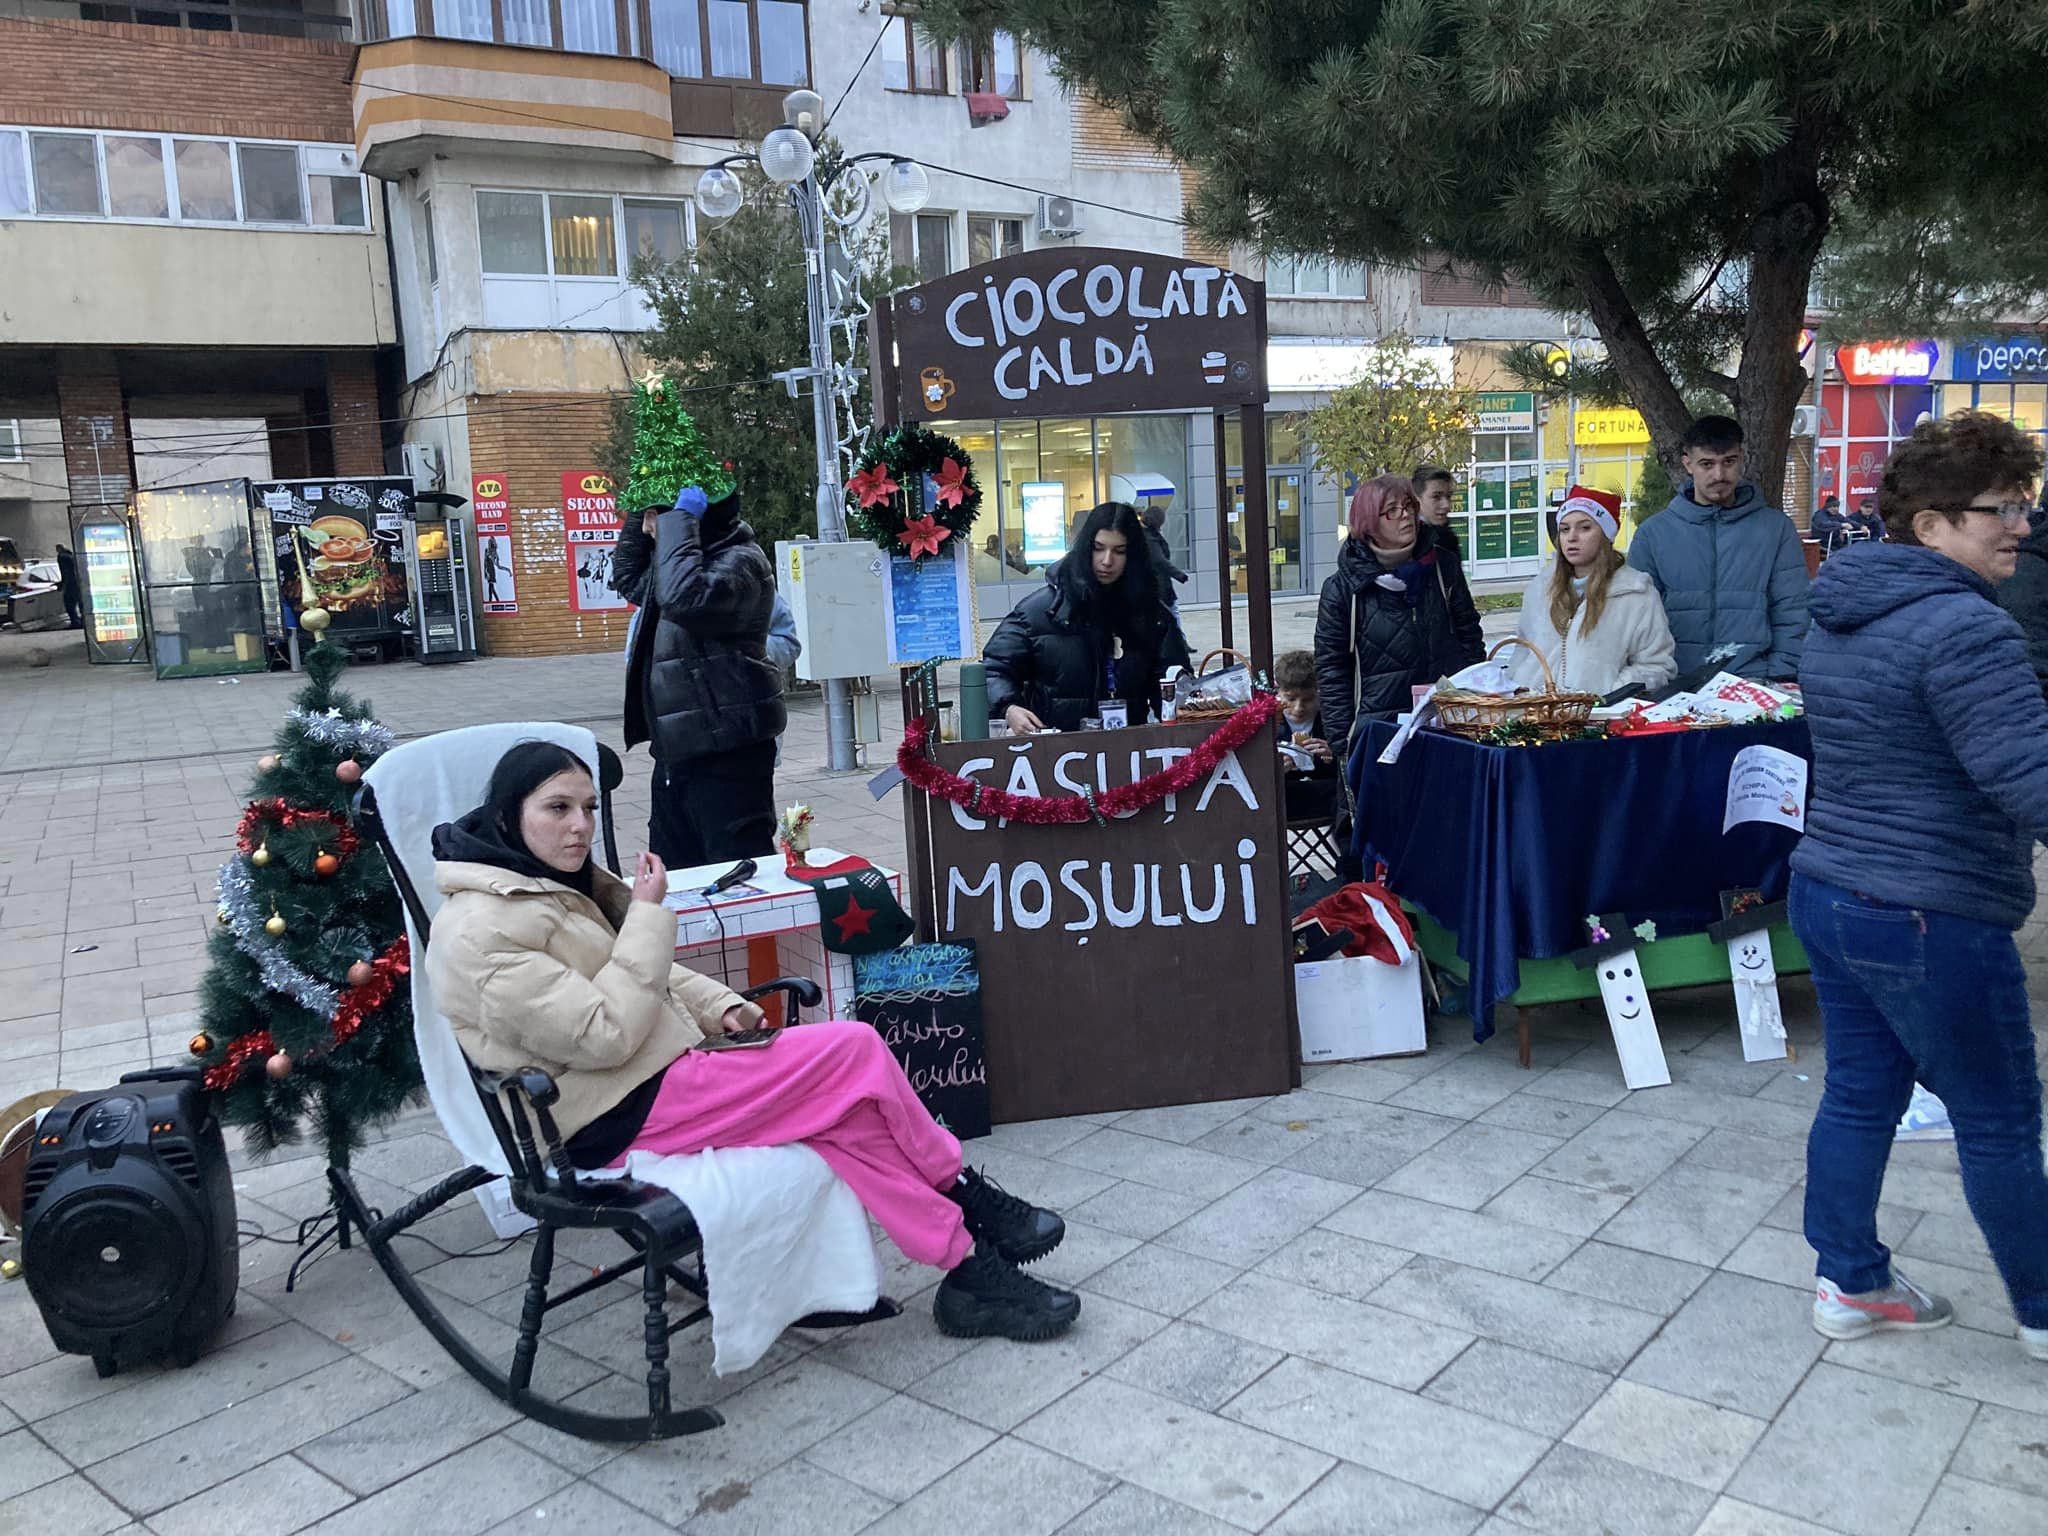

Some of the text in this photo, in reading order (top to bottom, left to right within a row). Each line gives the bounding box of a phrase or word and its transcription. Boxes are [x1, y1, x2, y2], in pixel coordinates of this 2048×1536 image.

[993, 322, 1154, 401] CALDĂ
[1475, 398, 1516, 411] MANET
[1577, 420, 1646, 434] FORTUNA
[479, 484, 501, 492] AVA
[475, 501, 507, 510] SECOND
[567, 497, 616, 511] SECON
[481, 510, 503, 519] HAND
[903, 1047, 987, 1098] oșului
